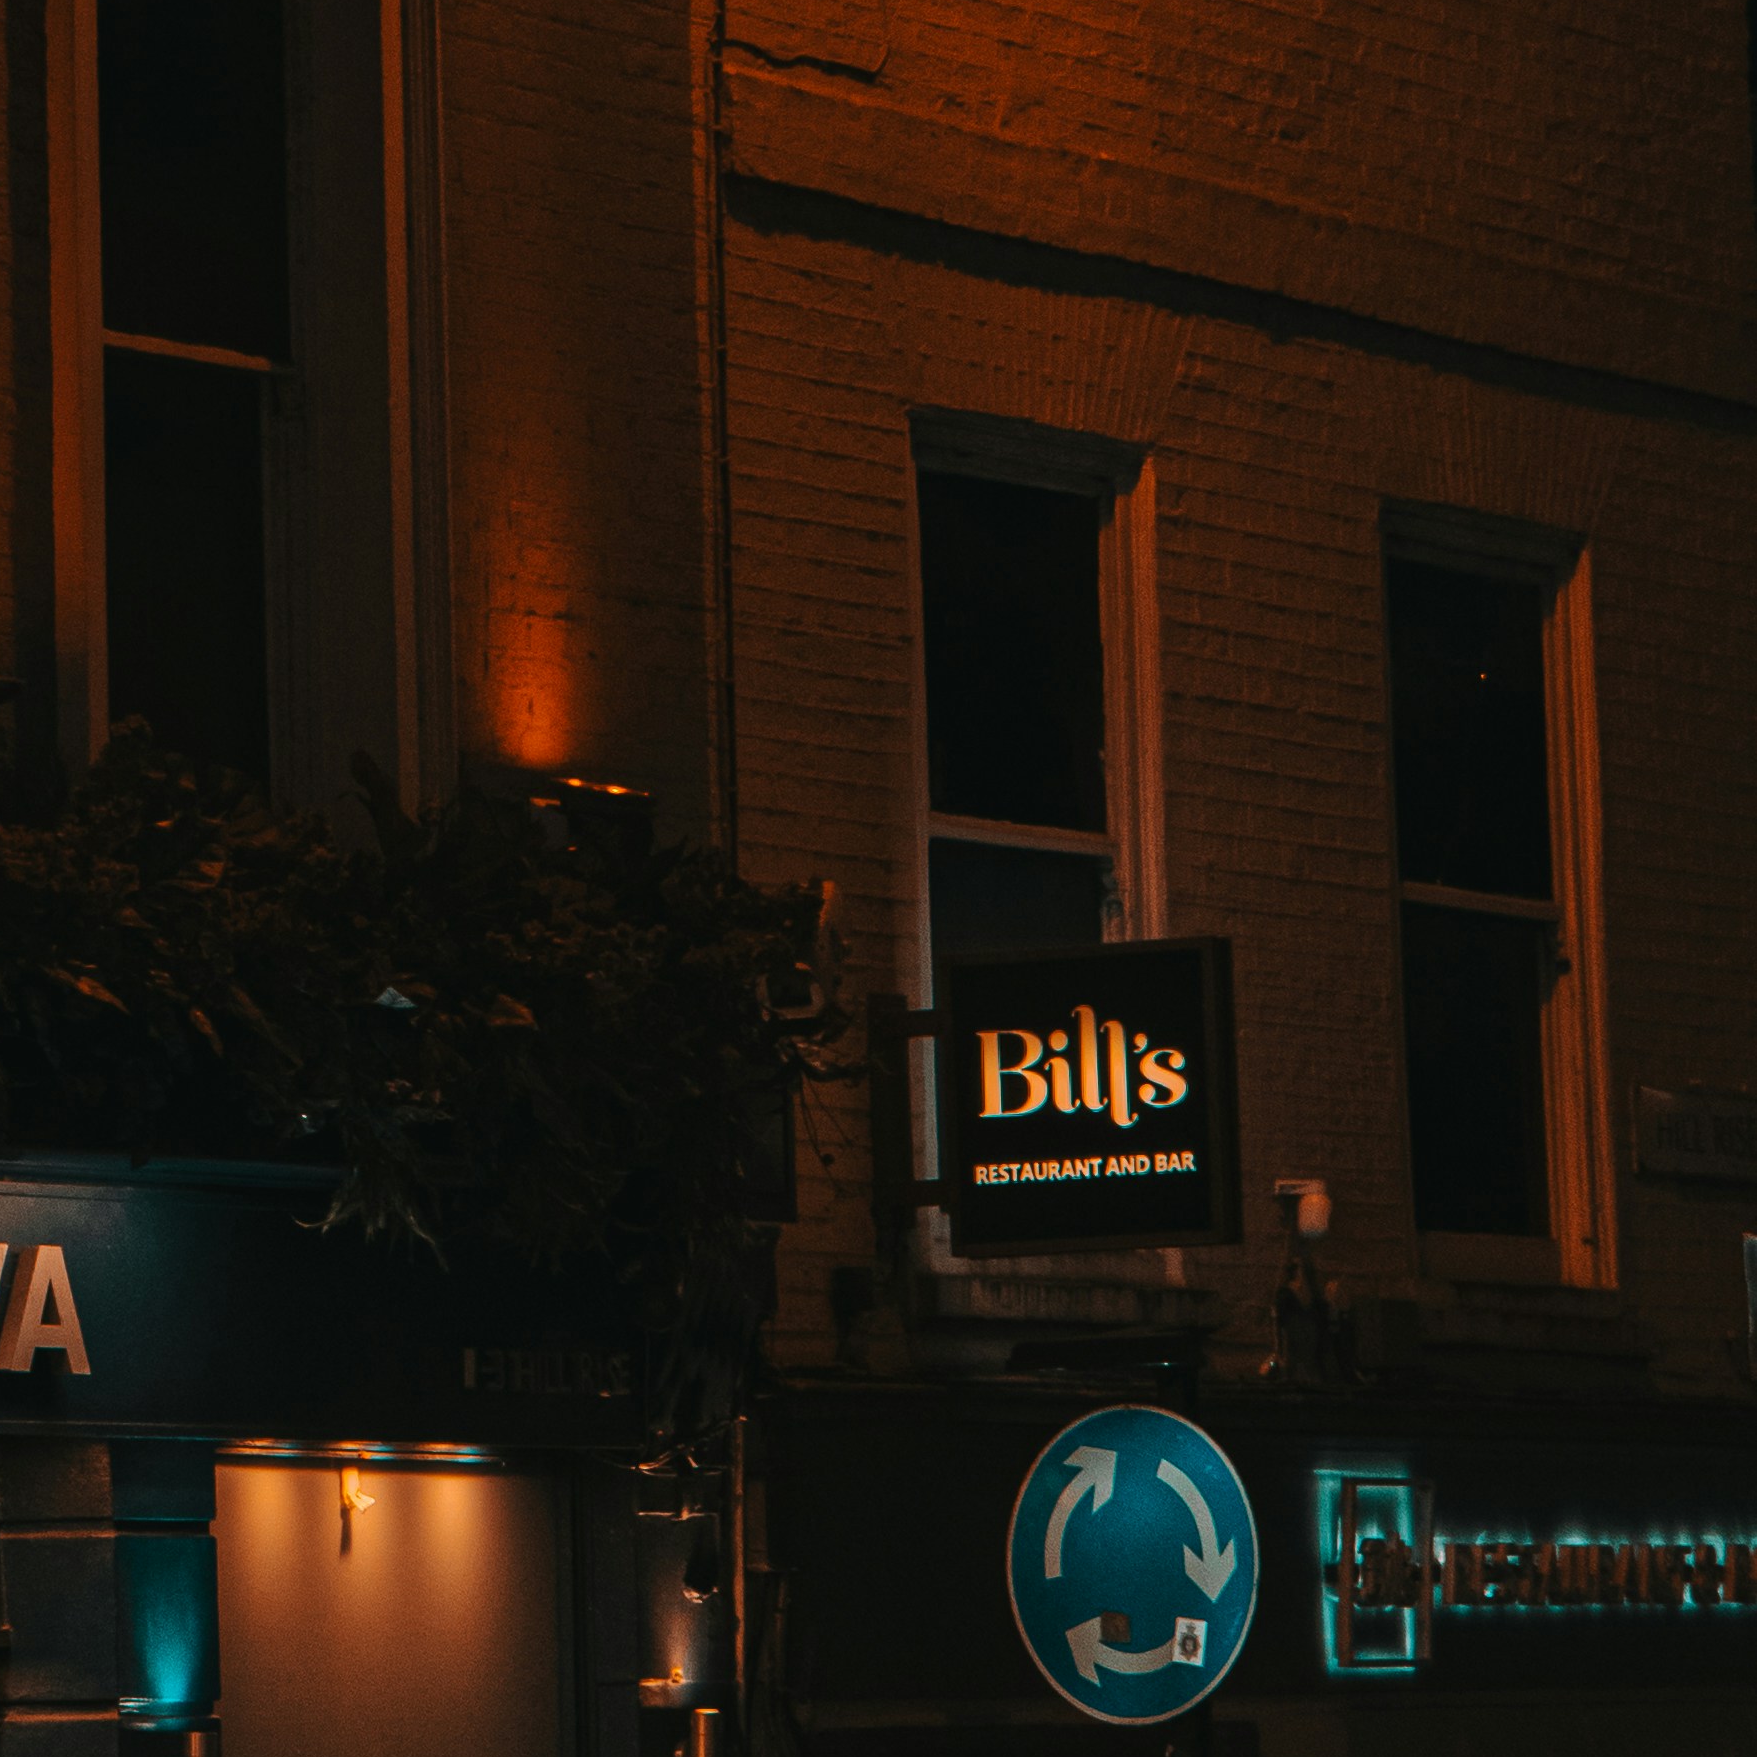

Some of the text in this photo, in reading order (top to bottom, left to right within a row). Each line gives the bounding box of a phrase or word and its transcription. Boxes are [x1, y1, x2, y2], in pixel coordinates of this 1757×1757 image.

[973, 1004, 1189, 1129] Bill's
[973, 1150, 1197, 1186] RESTAURANT AND BAR
